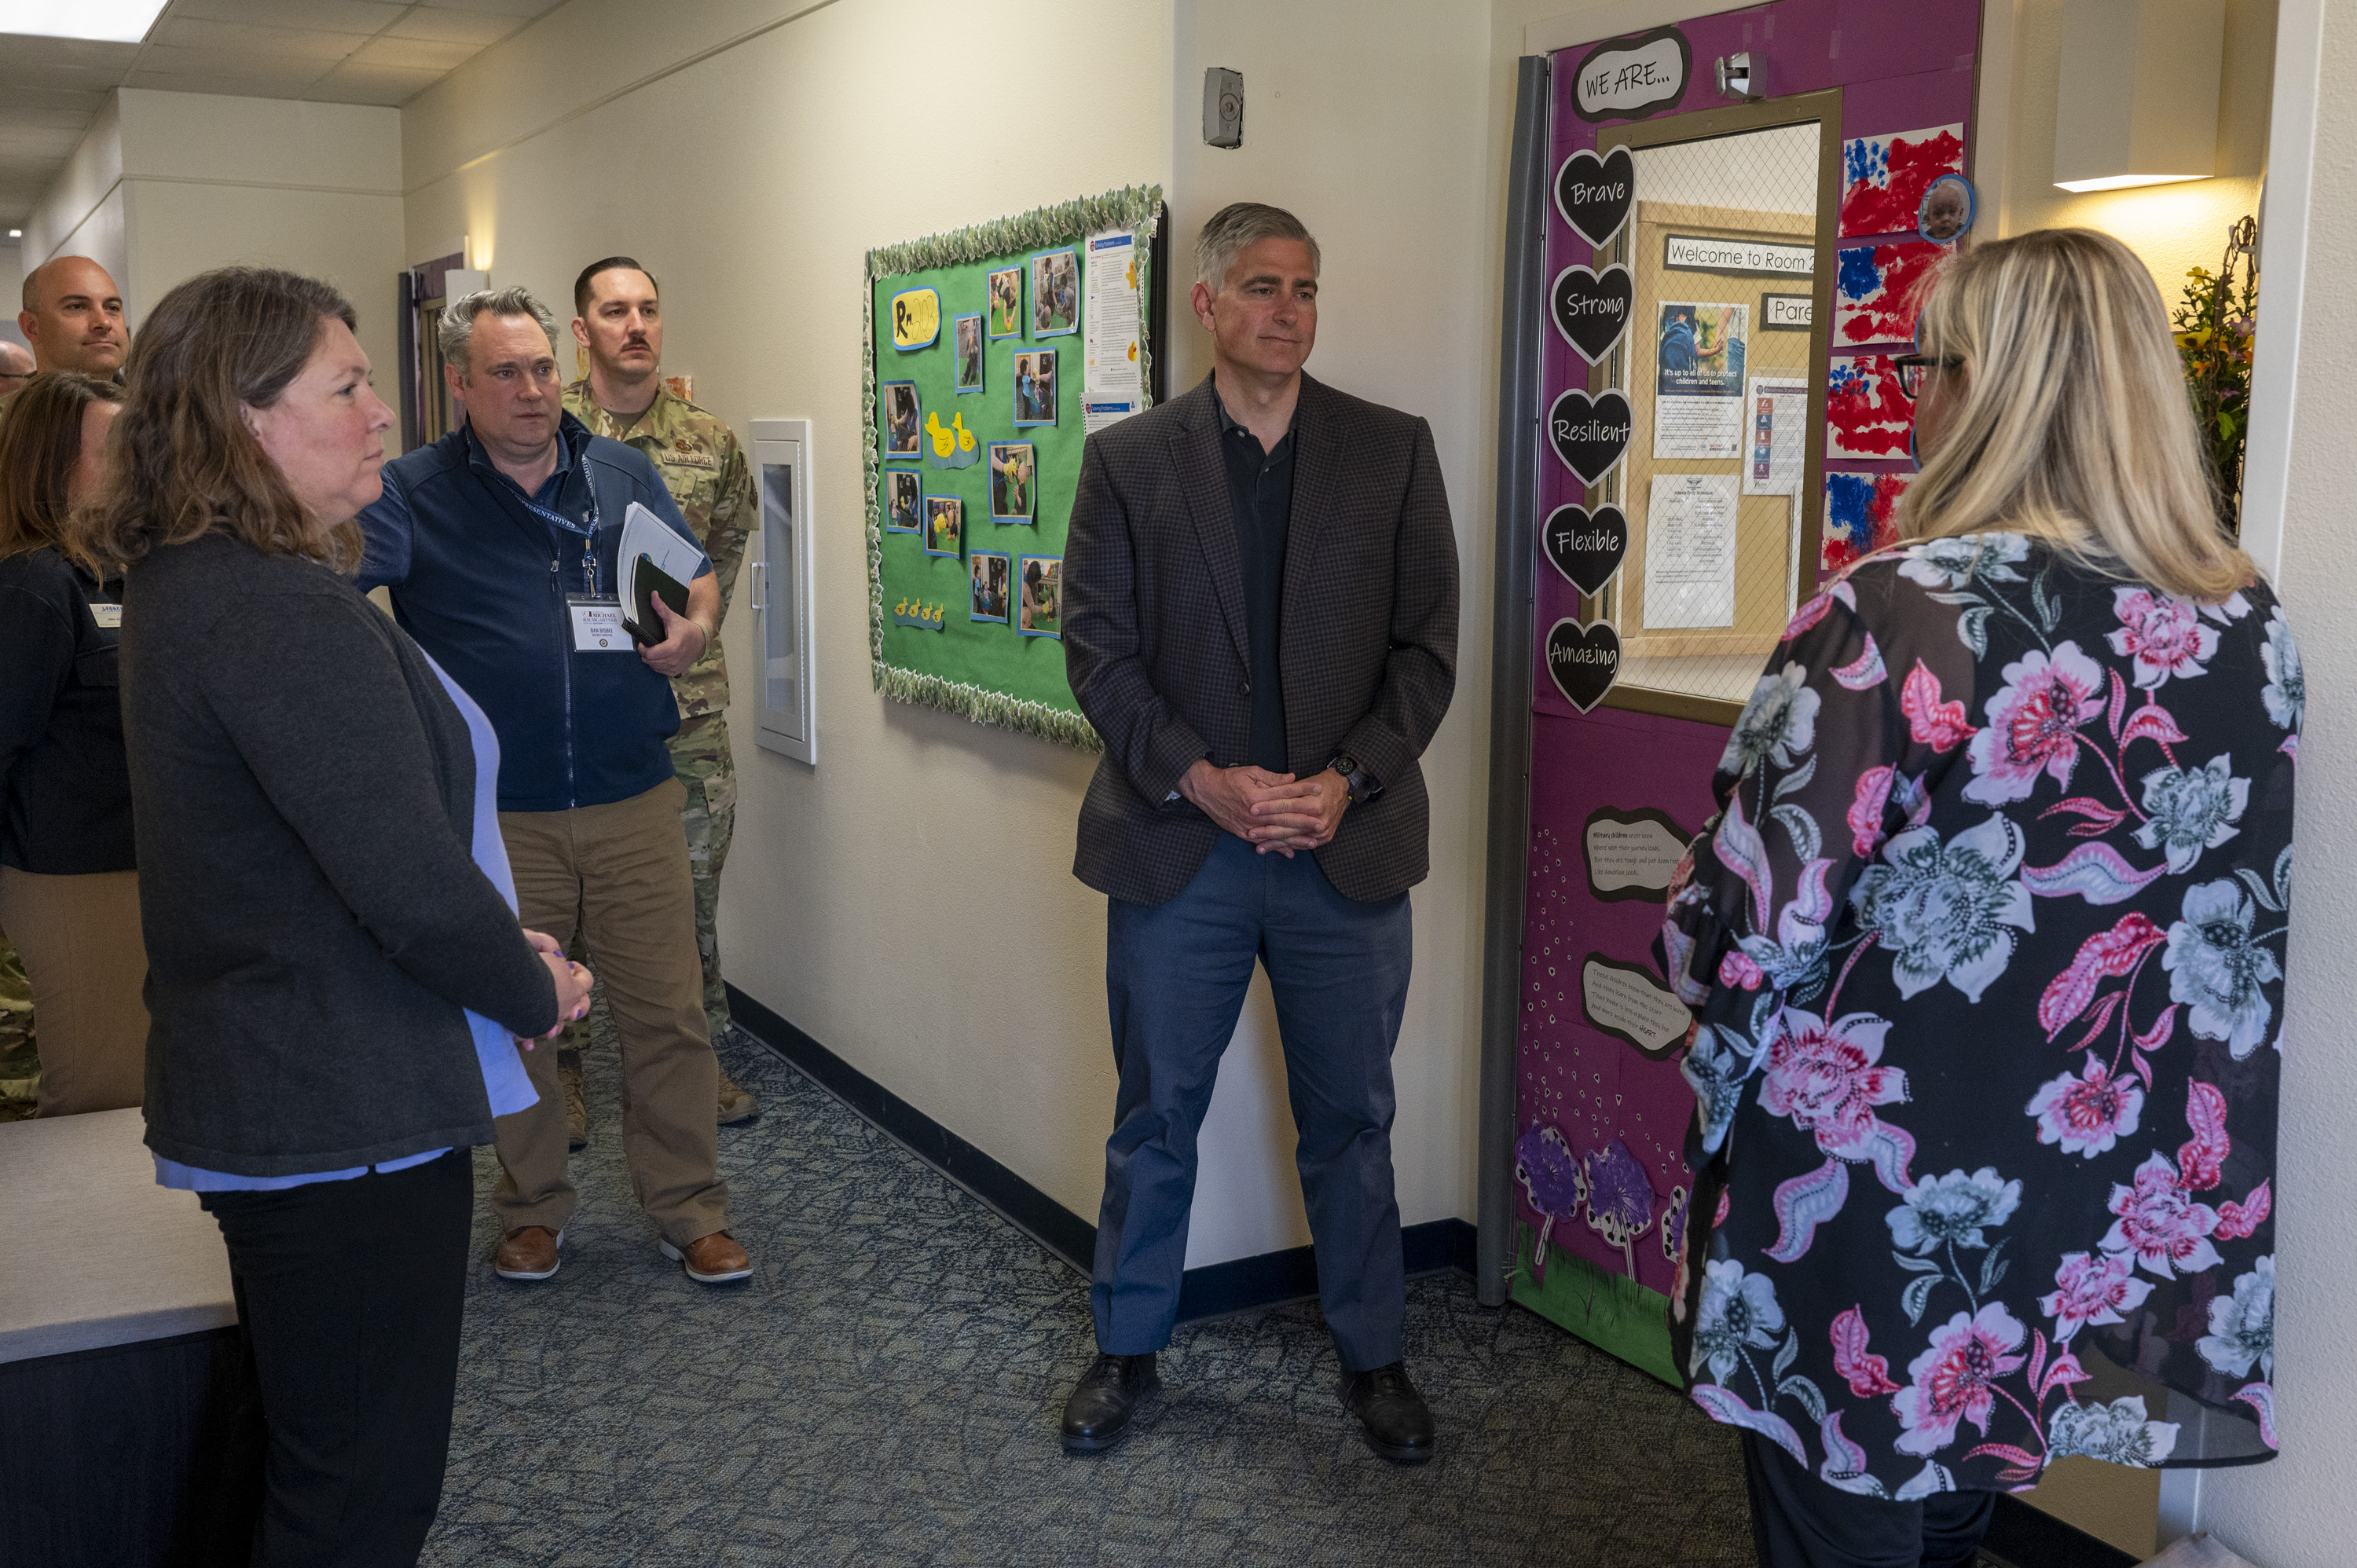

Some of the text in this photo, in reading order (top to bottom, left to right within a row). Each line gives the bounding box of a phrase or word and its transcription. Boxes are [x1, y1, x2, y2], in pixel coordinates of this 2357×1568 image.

[1585, 60, 1670, 99] WE ARE...
[1571, 181, 1625, 205] Brave
[1671, 244, 1815, 271] Welcome to Room 2
[911, 295, 935, 340] 203
[1567, 293, 1624, 322] Strong
[1775, 300, 1812, 321] Pare
[1553, 419, 1630, 442] Resilient
[664, 452, 712, 466] US AIR FORCE
[1555, 529, 1619, 554] Flexible
[1550, 642, 1618, 674] Amazing
[1603, 984, 1615, 995] they
[1615, 988, 1627, 999] learn
[1628, 995, 1639, 1005] from
[1648, 1006, 1662, 1016] start
[1609, 975, 1628, 987] children
[1628, 983, 1640, 994] know
[1640, 990, 1652, 999] that
[1653, 995, 1664, 1006] they
[1673, 1006, 1685, 1016] loved
[1591, 1002, 1657, 1040] And more inside their HEART.
[1592, 991, 1606, 1001] That
[1606, 997, 1618, 1008] home
[1624, 1006, 1633, 1015] less
[1637, 1013, 1650, 1023] place
[1650, 1018, 1661, 1029] they
[1661, 1024, 1670, 1033] live
